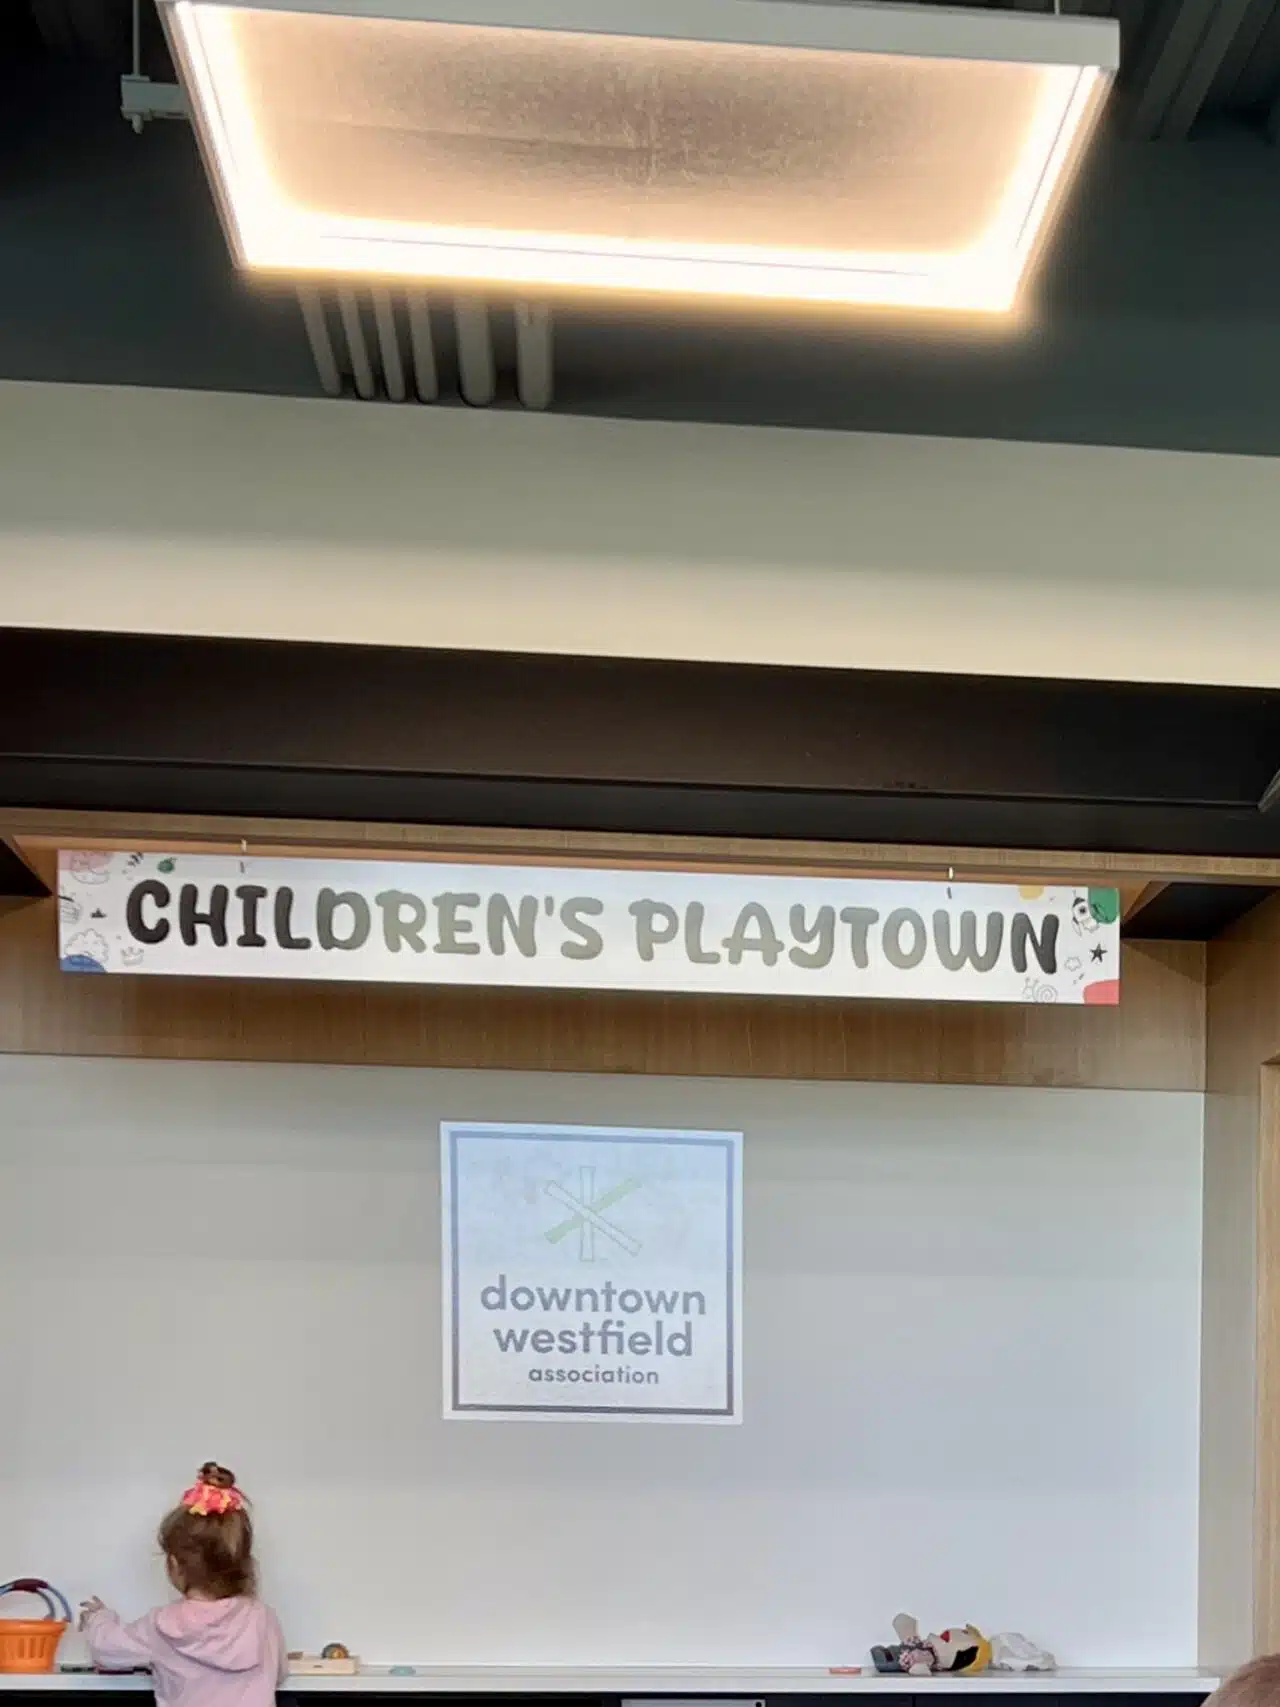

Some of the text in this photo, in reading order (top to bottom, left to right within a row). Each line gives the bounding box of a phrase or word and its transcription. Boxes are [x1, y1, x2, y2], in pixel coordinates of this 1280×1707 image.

[125, 879, 1060, 975] CHILDREN'S PLAYTOWN
[480, 1273, 706, 1316] downtown
[492, 1319, 693, 1358] westfield
[528, 1363, 660, 1385] association
